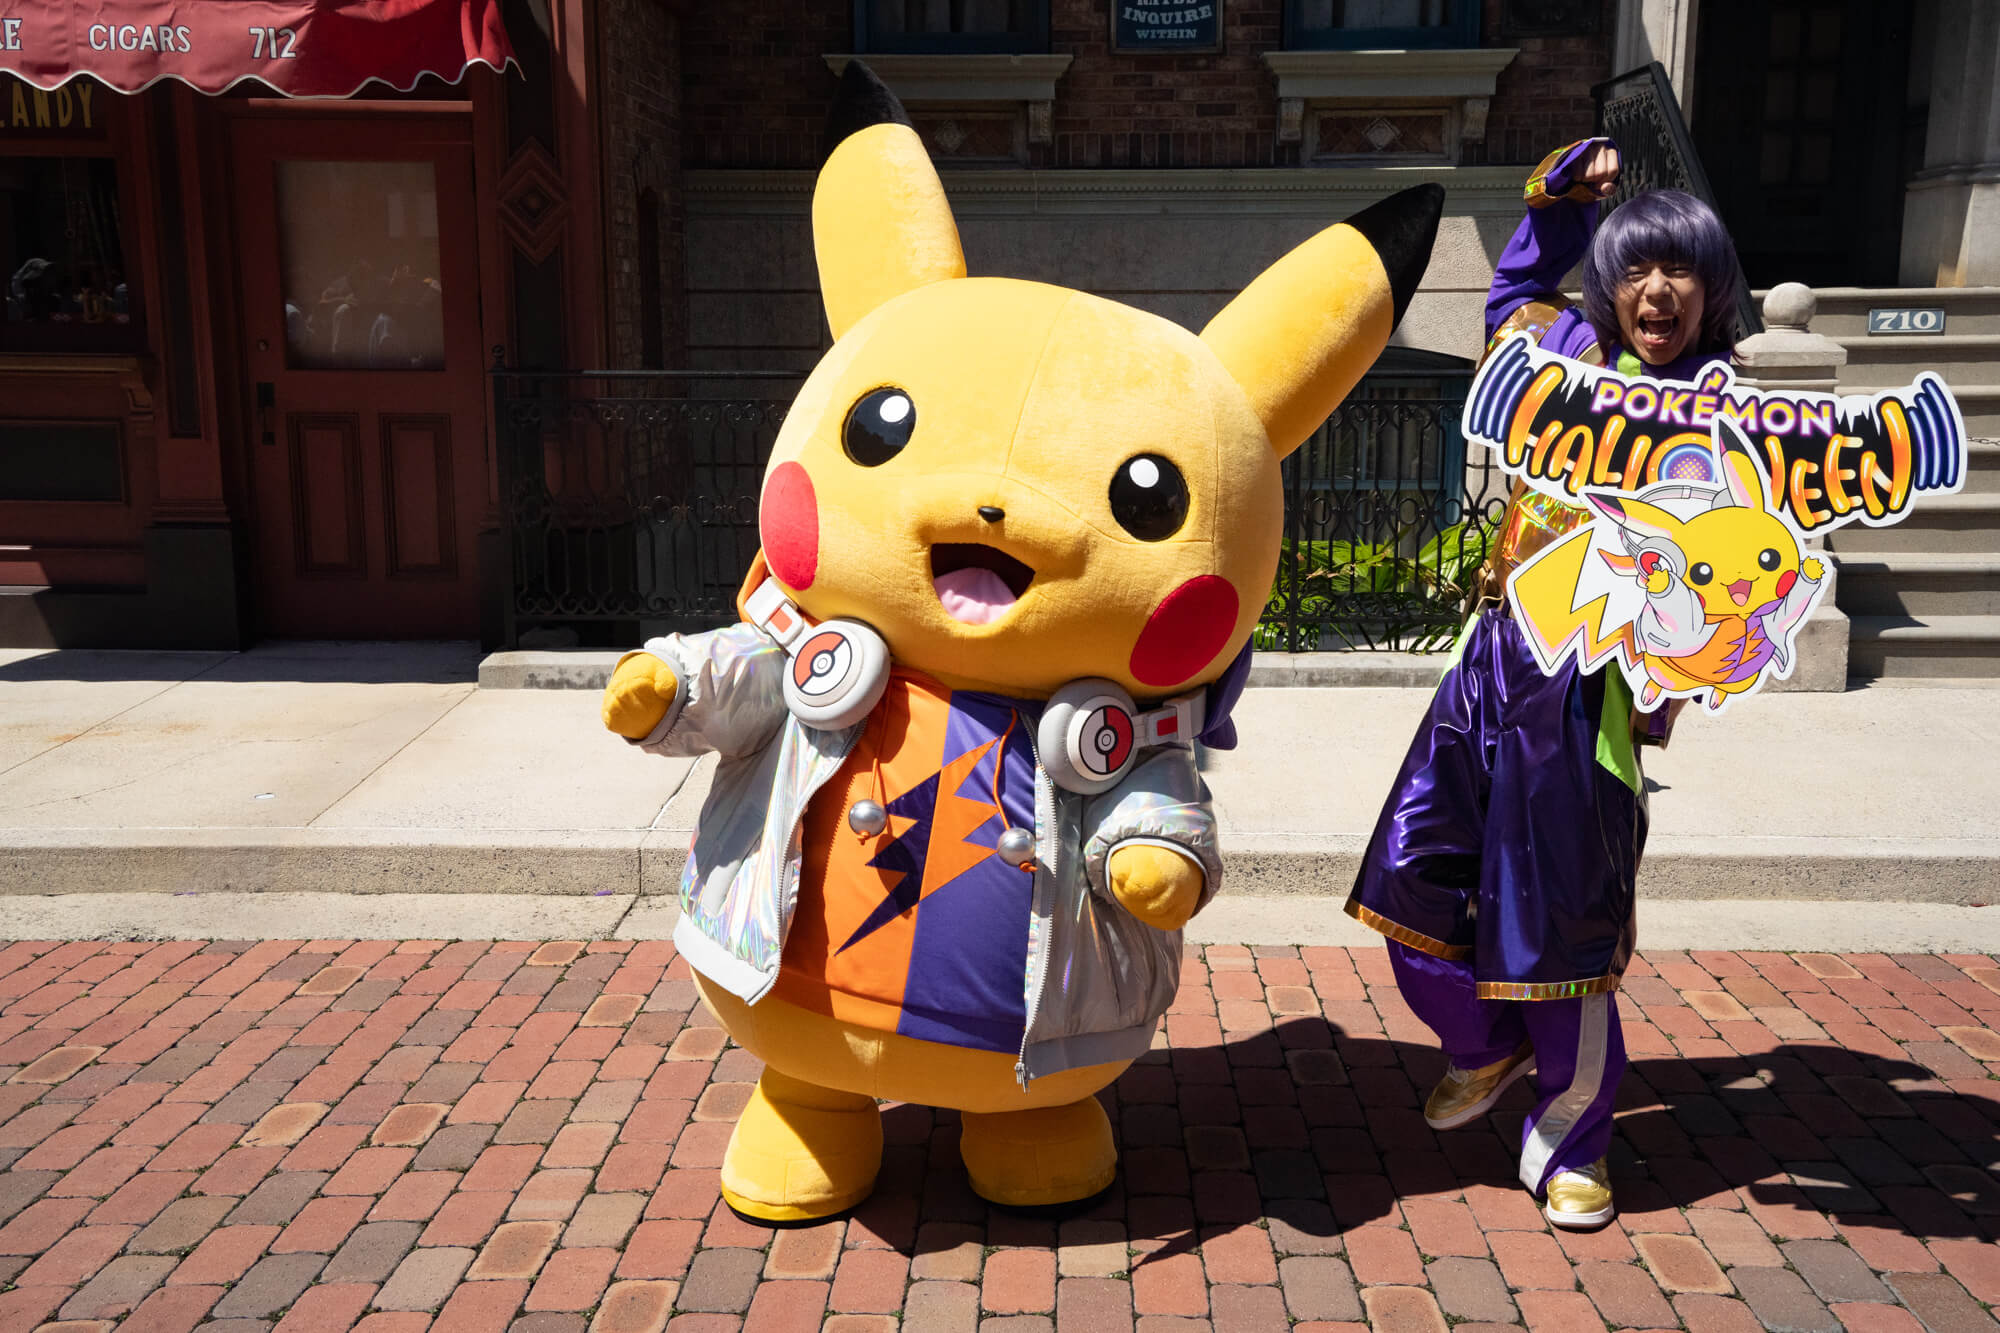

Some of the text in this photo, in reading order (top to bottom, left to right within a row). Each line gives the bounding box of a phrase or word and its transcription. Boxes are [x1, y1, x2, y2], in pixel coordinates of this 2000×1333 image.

[1122, 5, 1213, 25] INQUIRE
[88, 24, 192, 53] CIGARS
[249, 27, 297, 59] 712
[1136, 28, 1198, 40] WITHIN
[0, 80, 93, 128] ANDY
[1875, 311, 1937, 329] 710
[1591, 368, 1836, 437] POKÉMON
